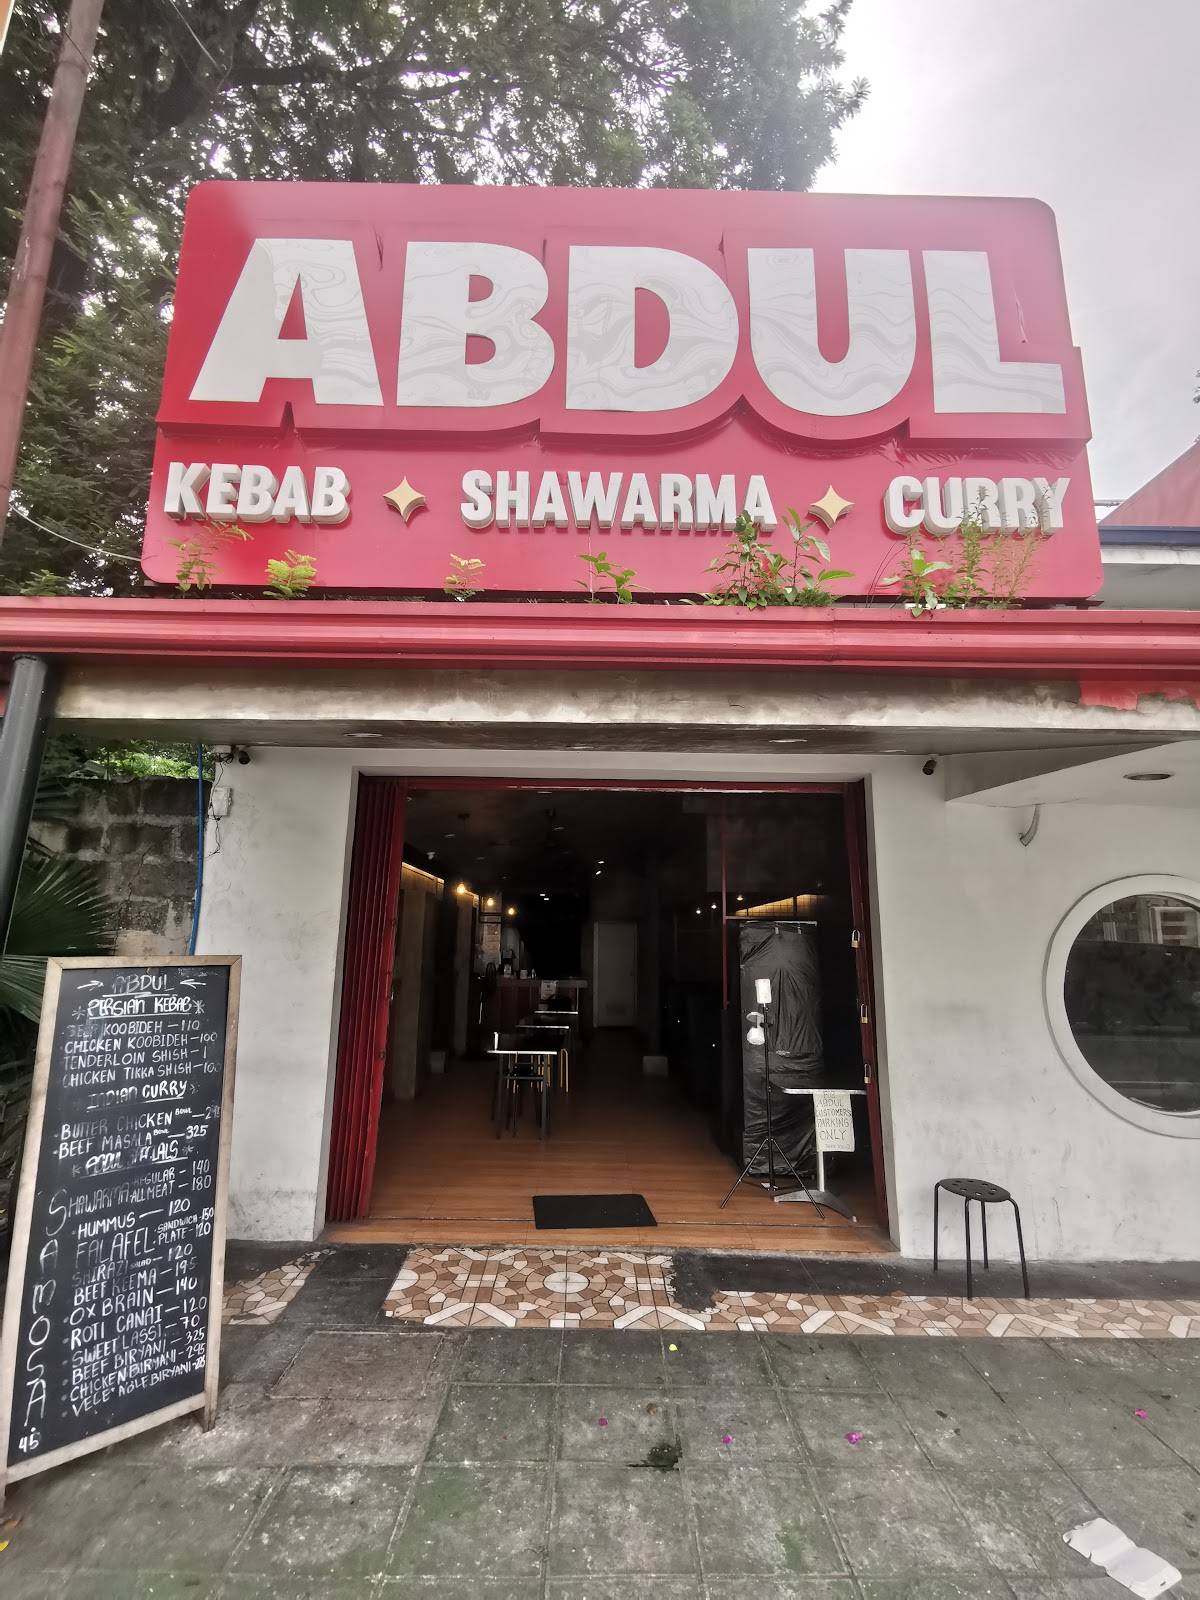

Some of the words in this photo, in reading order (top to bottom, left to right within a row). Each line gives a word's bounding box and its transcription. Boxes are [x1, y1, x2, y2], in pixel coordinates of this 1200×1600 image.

[187, 237, 1067, 417] ABDUL
[164, 462, 351, 524] KEBAB
[460, 469, 778, 531] SHAWARMA
[884, 476, 1070, 535] CURRY
[87, 997, 145, 1016] PERSIAN
[154, 996, 192, 1014] KEBAB
[103, 1020, 163, 1036] KOOBIDEH
[64, 1038, 122, 1054] CHICKEN
[127, 1033, 188, 1050] KOOBIDEH
[63, 1052, 145, 1071] TENDERLOIN
[152, 1047, 188, 1063] SHISH
[62, 1071, 116, 1089] CHICKEN
[124, 1066, 154, 1081] TIKKA
[157, 1061, 192, 1077] SHISH
[142, 1080, 187, 1099] CURRY
[117, 1111, 173, 1132] CHICKEN
[816, 1118, 850, 1128] PARKING
[58, 1137, 95, 1161] BEEF
[101, 1132, 152, 1151] MASALA
[185, 1125, 209, 1139] 325
[820, 1129, 847, 1140] ONLY
[192, 1159, 210, 1176] 140
[192, 1174, 212, 1191] 180
[77, 1211, 136, 1240] HUMMUS
[168, 1198, 191, 1217] 120
[76, 1226, 156, 1270] FALAFEL
[157, 1213, 199, 1233] SANDWICH
[158, 1228, 187, 1245] PLATE
[196, 1222, 212, 1238] 120
[168, 1243, 193, 1261] 120
[69, 1303, 97, 1325] OX
[102, 1286, 155, 1317] BRAIN
[74, 1280, 108, 1306] BEEF
[70, 1322, 105, 1350] ROTI
[116, 1303, 164, 1333] CANAI
[183, 1296, 208, 1314] 120
[72, 1337, 119, 1368] SWEET
[122, 1324, 162, 1350] LASSI
[180, 1315, 200, 1329] 70
[72, 1358, 110, 1386] BEEF
[114, 1338, 167, 1370] BIRYANI
[185, 1326, 206, 1346] 325
[70, 1368, 127, 1401] CHICKEN
[129, 1349, 177, 1379] BIRYANI
[150, 1361, 192, 1386] BIRYANI
